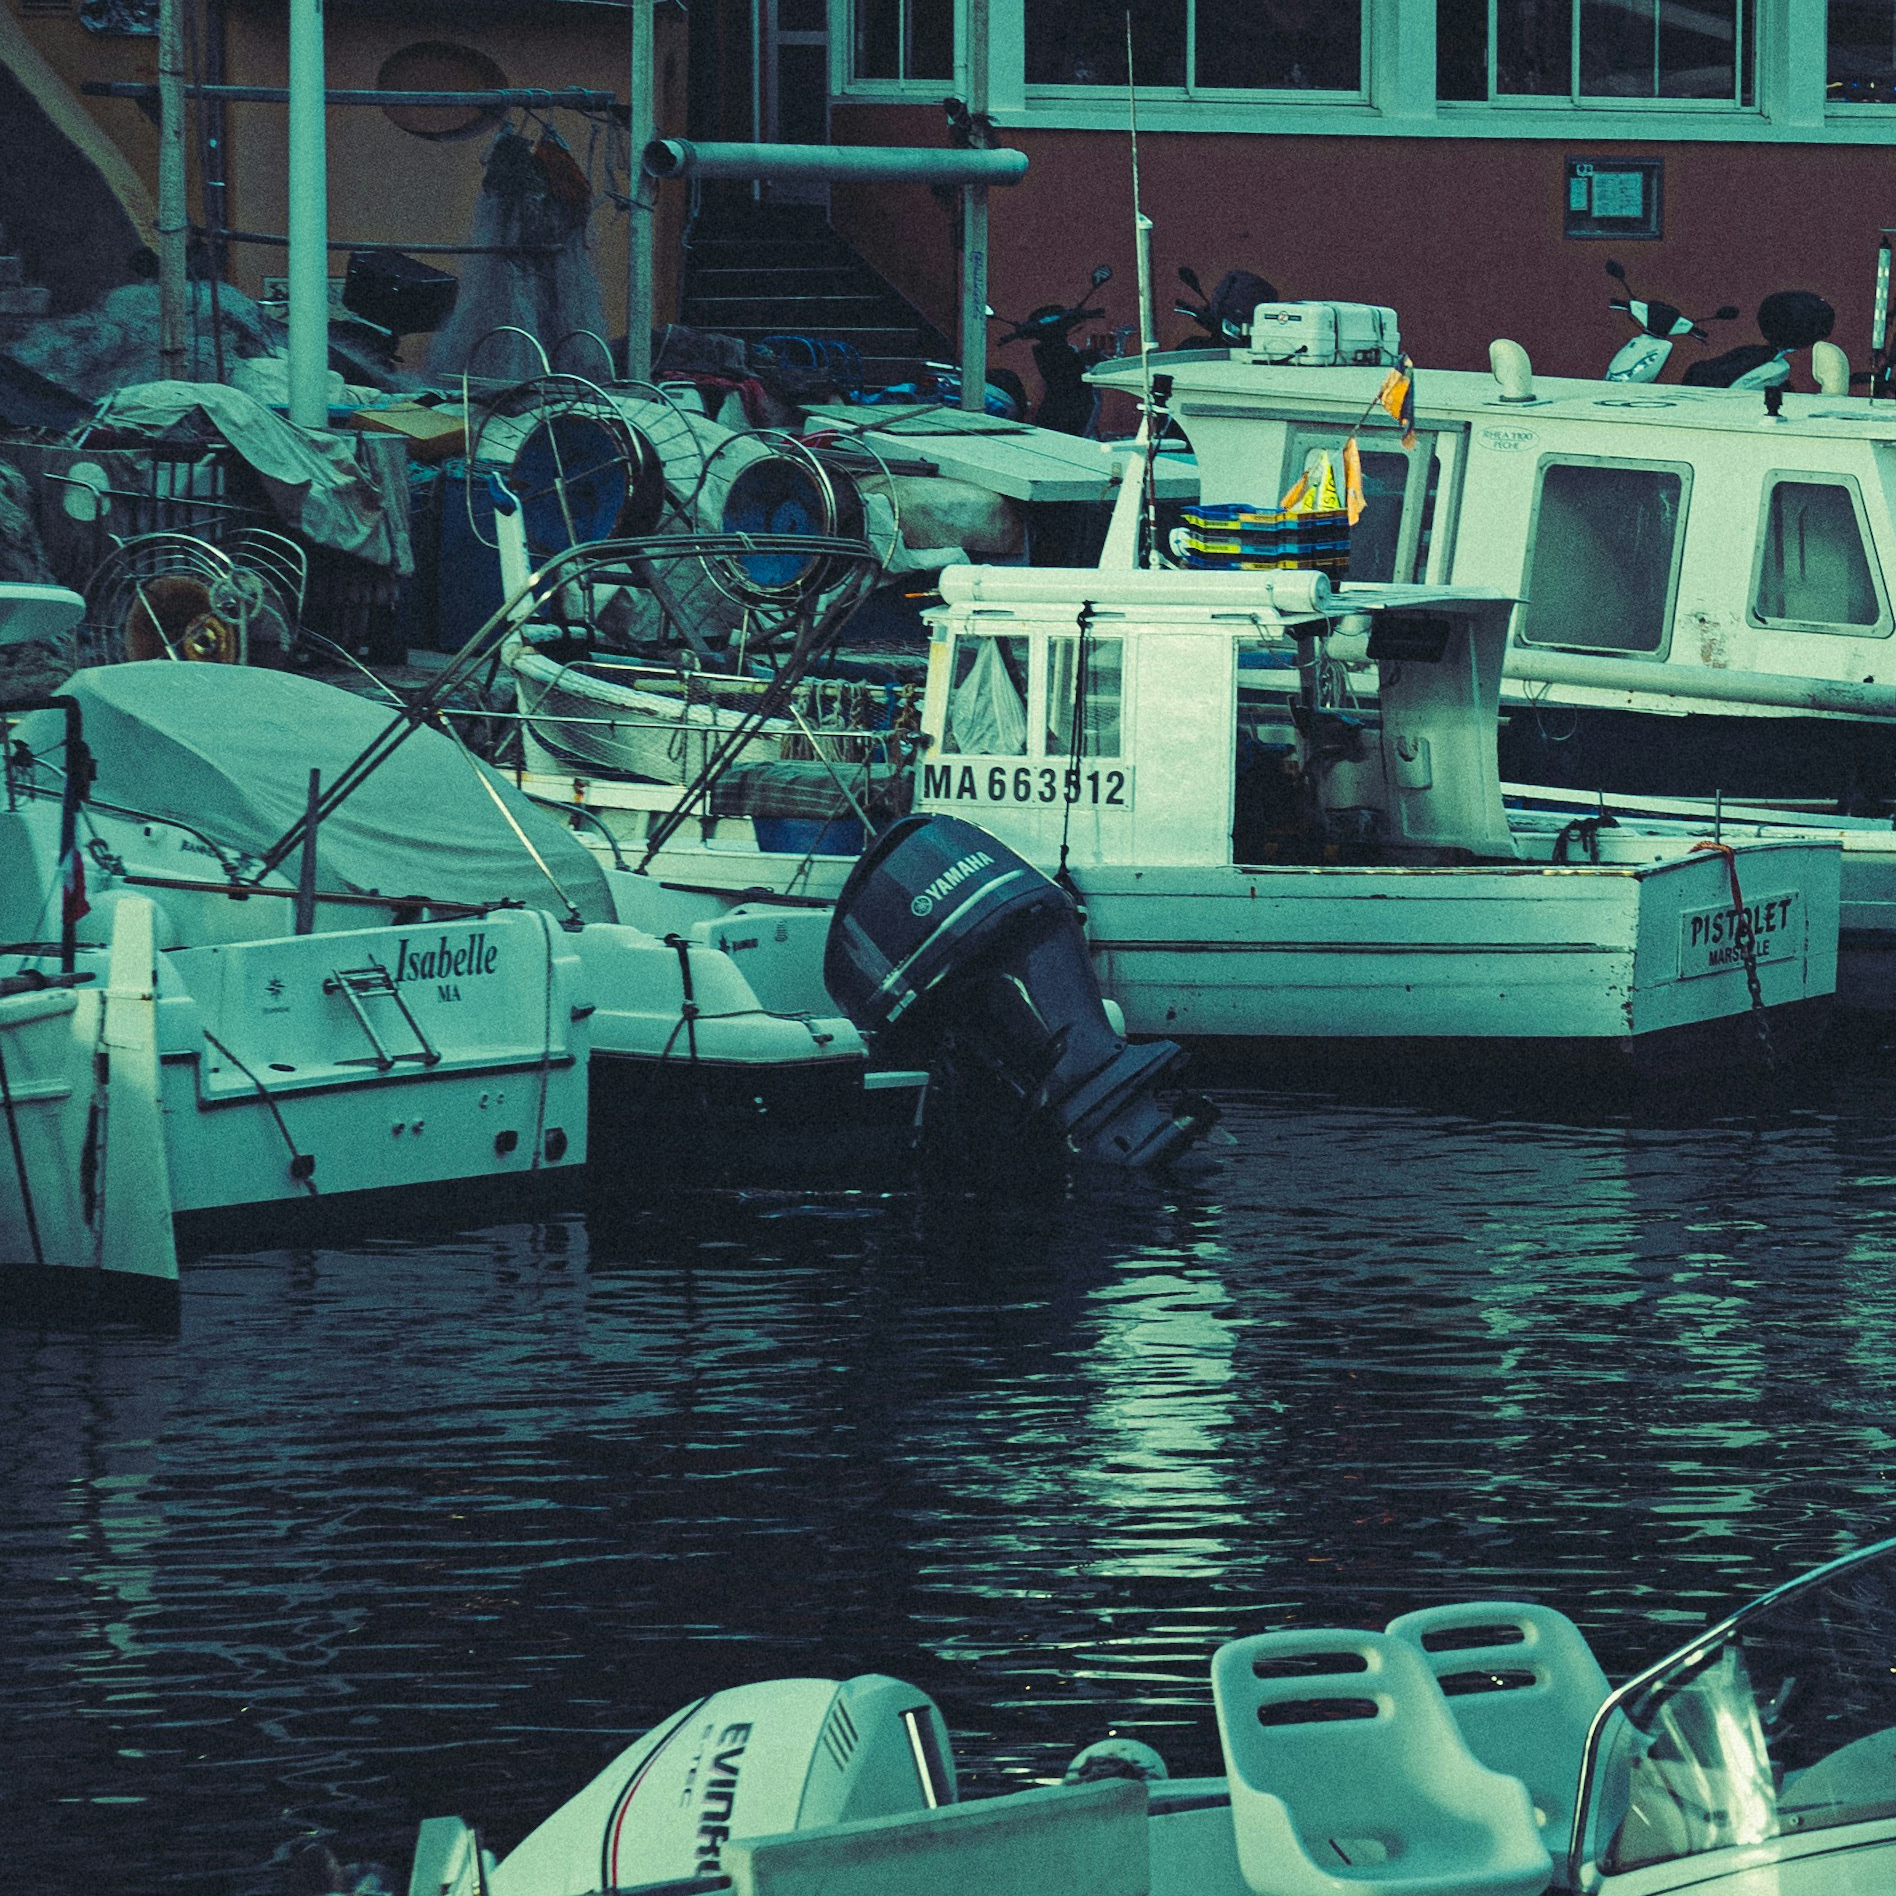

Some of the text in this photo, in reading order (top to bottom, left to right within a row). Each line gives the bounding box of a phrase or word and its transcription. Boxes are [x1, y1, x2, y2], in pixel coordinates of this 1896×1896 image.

[923, 763, 978, 800] MA
[924, 850, 996, 902] YAMAHA
[394, 933, 498, 983] Isabelle
[1709, 939, 1771, 967] MARSLE
[437, 985, 462, 1003] MA
